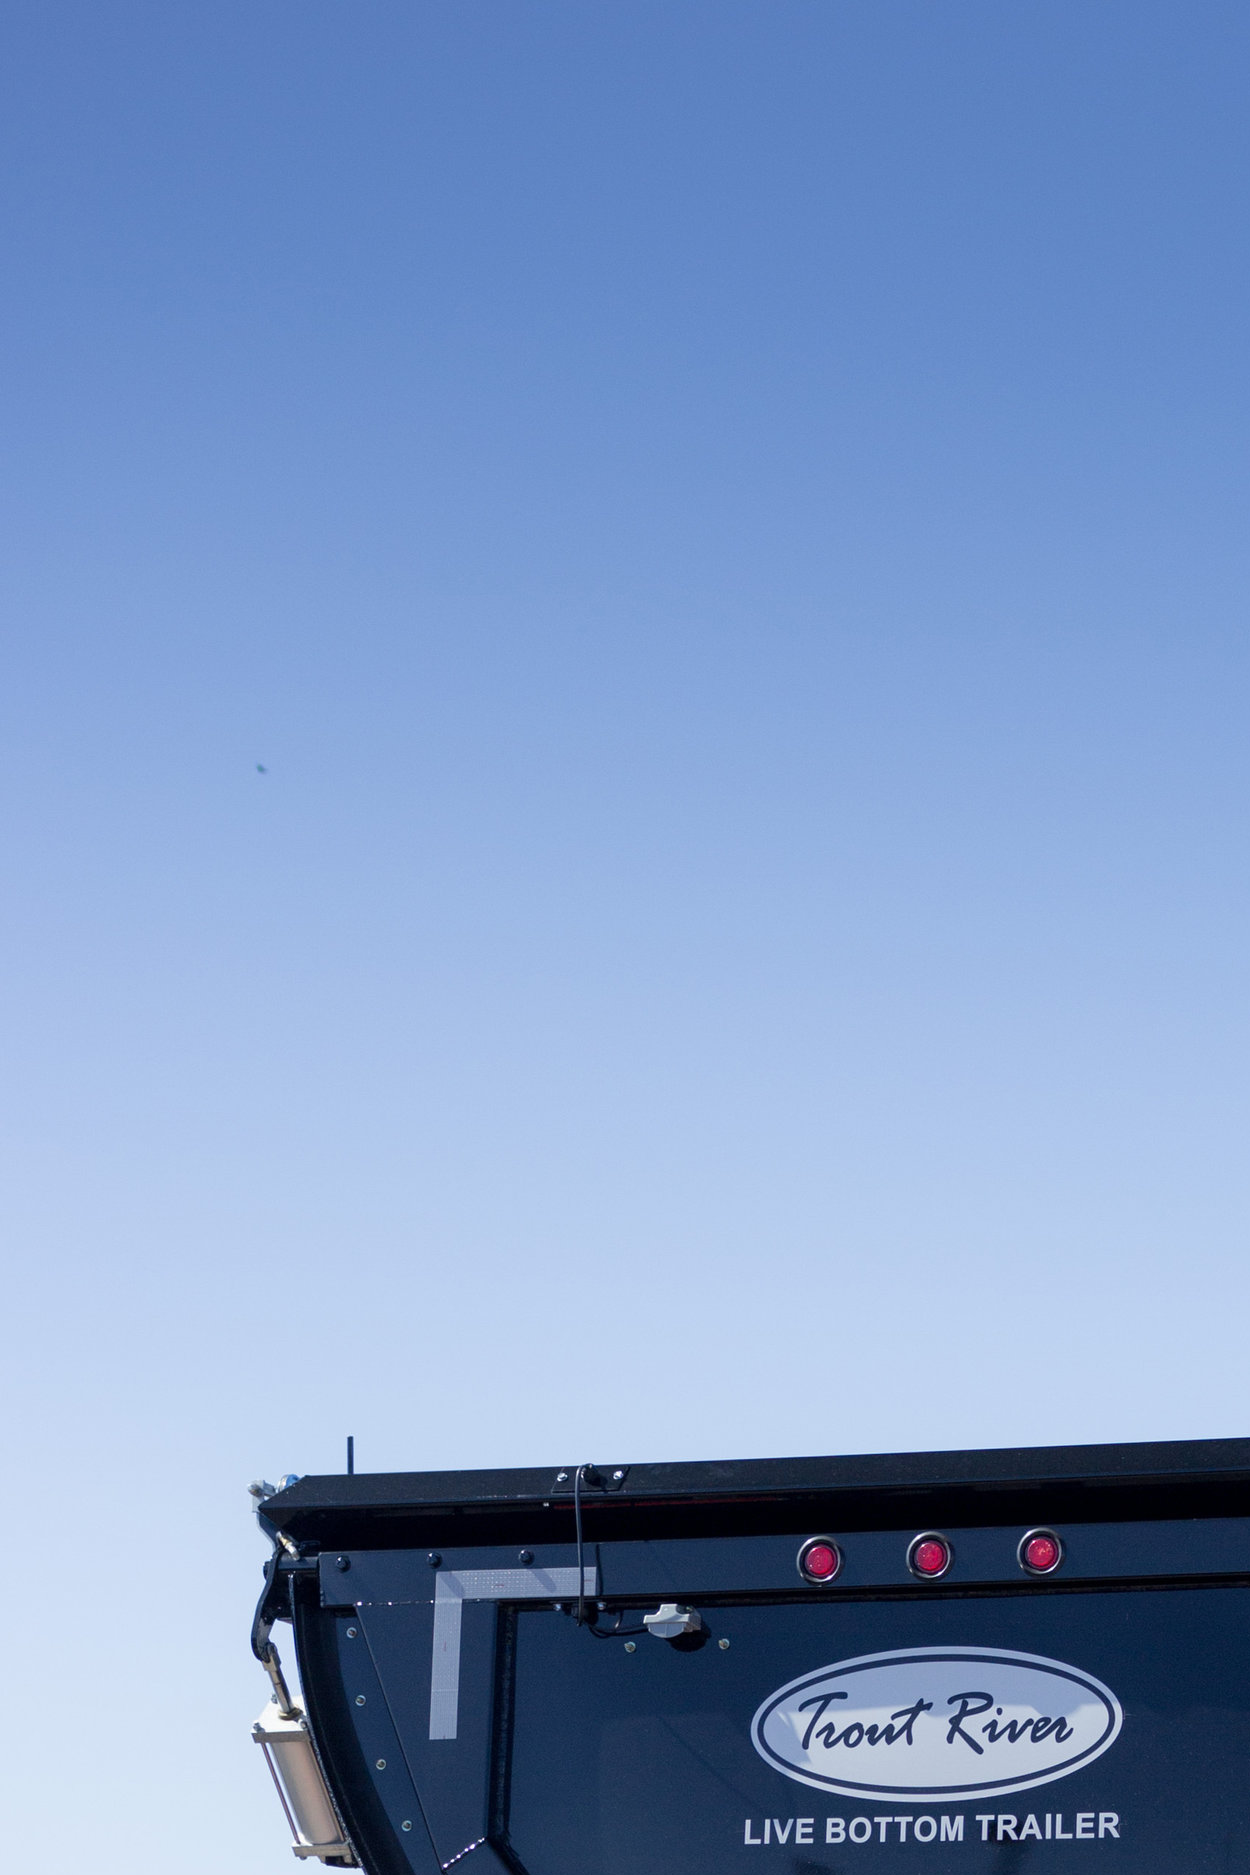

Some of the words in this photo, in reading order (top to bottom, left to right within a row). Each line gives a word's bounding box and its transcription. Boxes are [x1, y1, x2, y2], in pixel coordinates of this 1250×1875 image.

[799, 1692, 933, 1750] Trout
[947, 1692, 1074, 1755] River
[744, 1818, 814, 1845] LIVE
[825, 1815, 965, 1844] BOTTOM
[975, 1812, 1120, 1841] TRAILER
